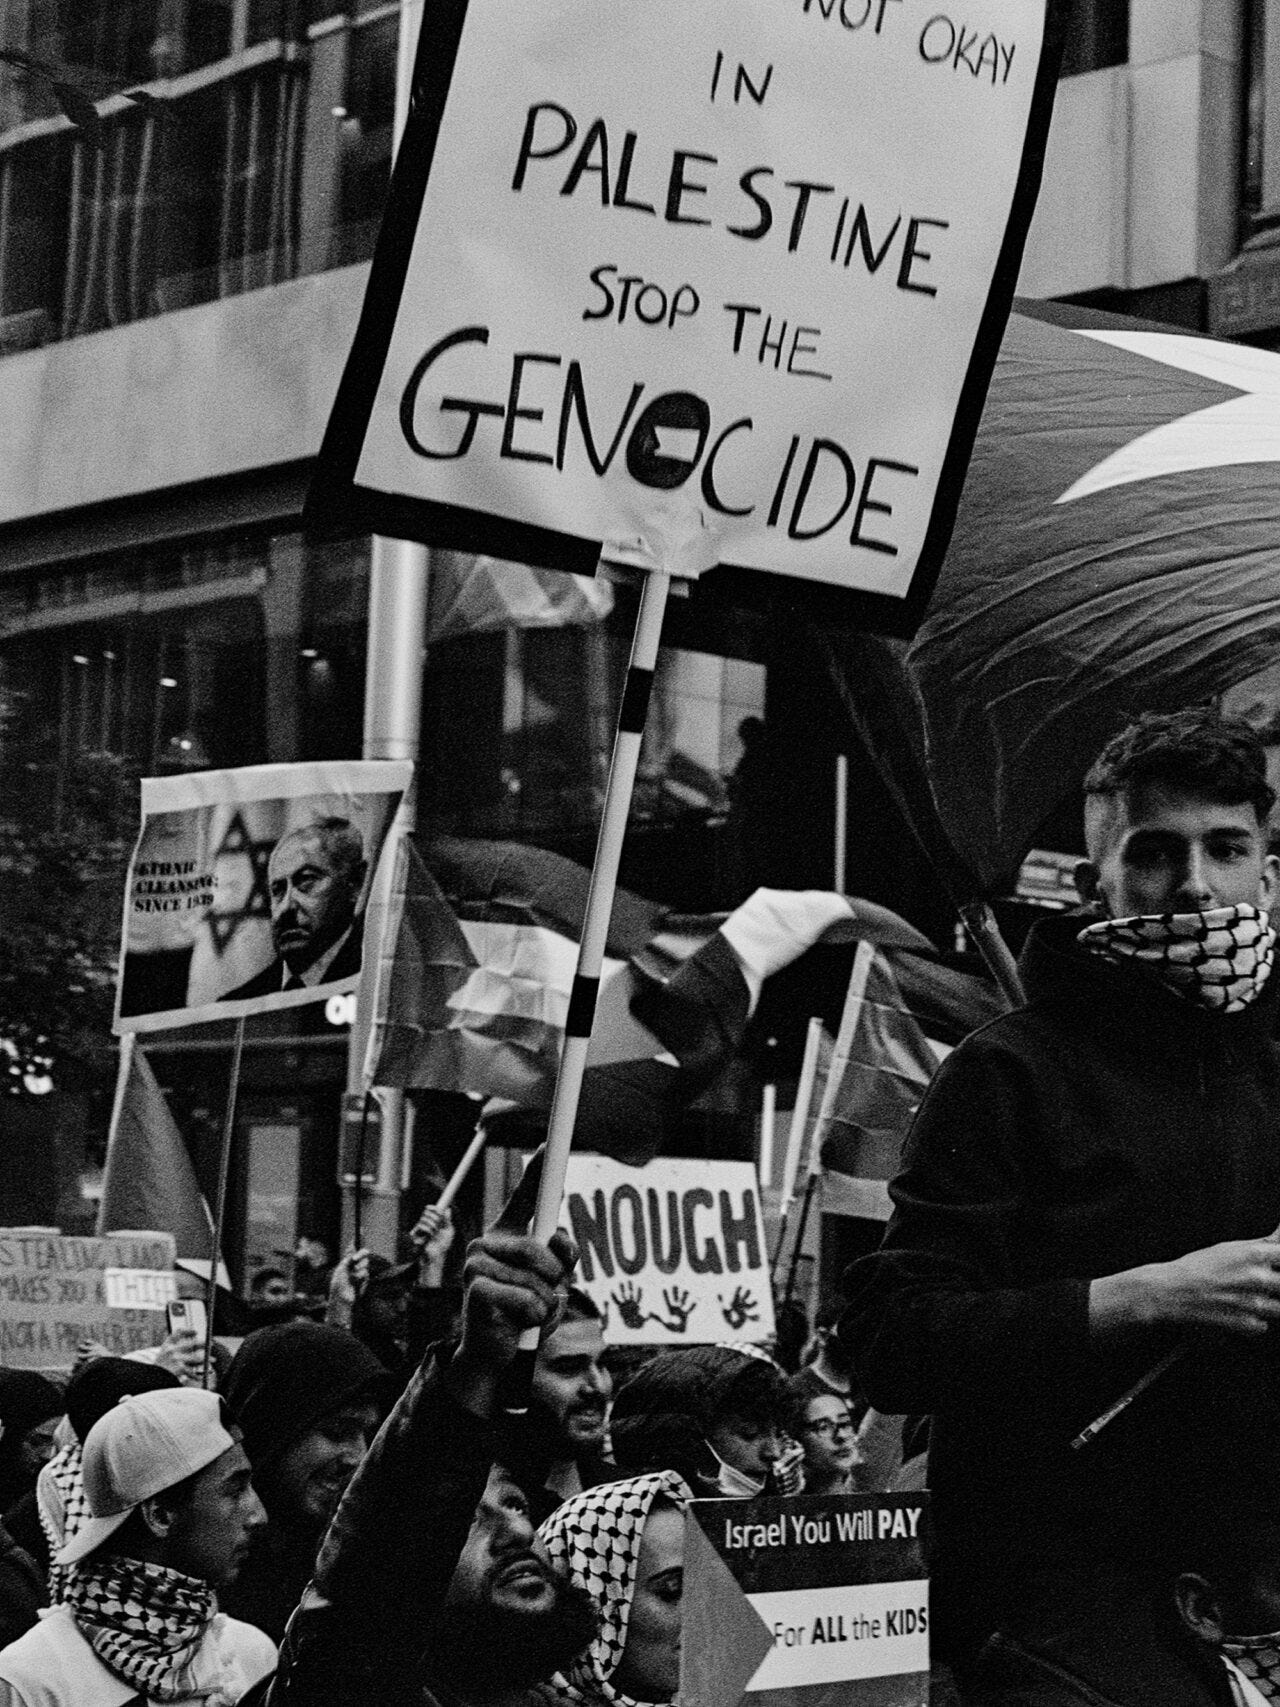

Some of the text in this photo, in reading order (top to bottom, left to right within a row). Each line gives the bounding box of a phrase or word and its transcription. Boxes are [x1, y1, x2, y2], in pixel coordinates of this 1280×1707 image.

[710, 51, 773, 104] IN
[919, 14, 1016, 85] OKAY
[511, 101, 950, 297] PALESTINE
[582, 265, 832, 380] STOP THE
[399, 326, 920, 557] GENOCIDE
[137, 861, 197, 876] ETHNIC
[135, 898, 181, 912] SINCE
[568, 1183, 762, 1282] NOUGH
[725, 1507, 922, 1549] Israel You Will PAY
[773, 1606, 928, 1648] For ALL the KIDS
